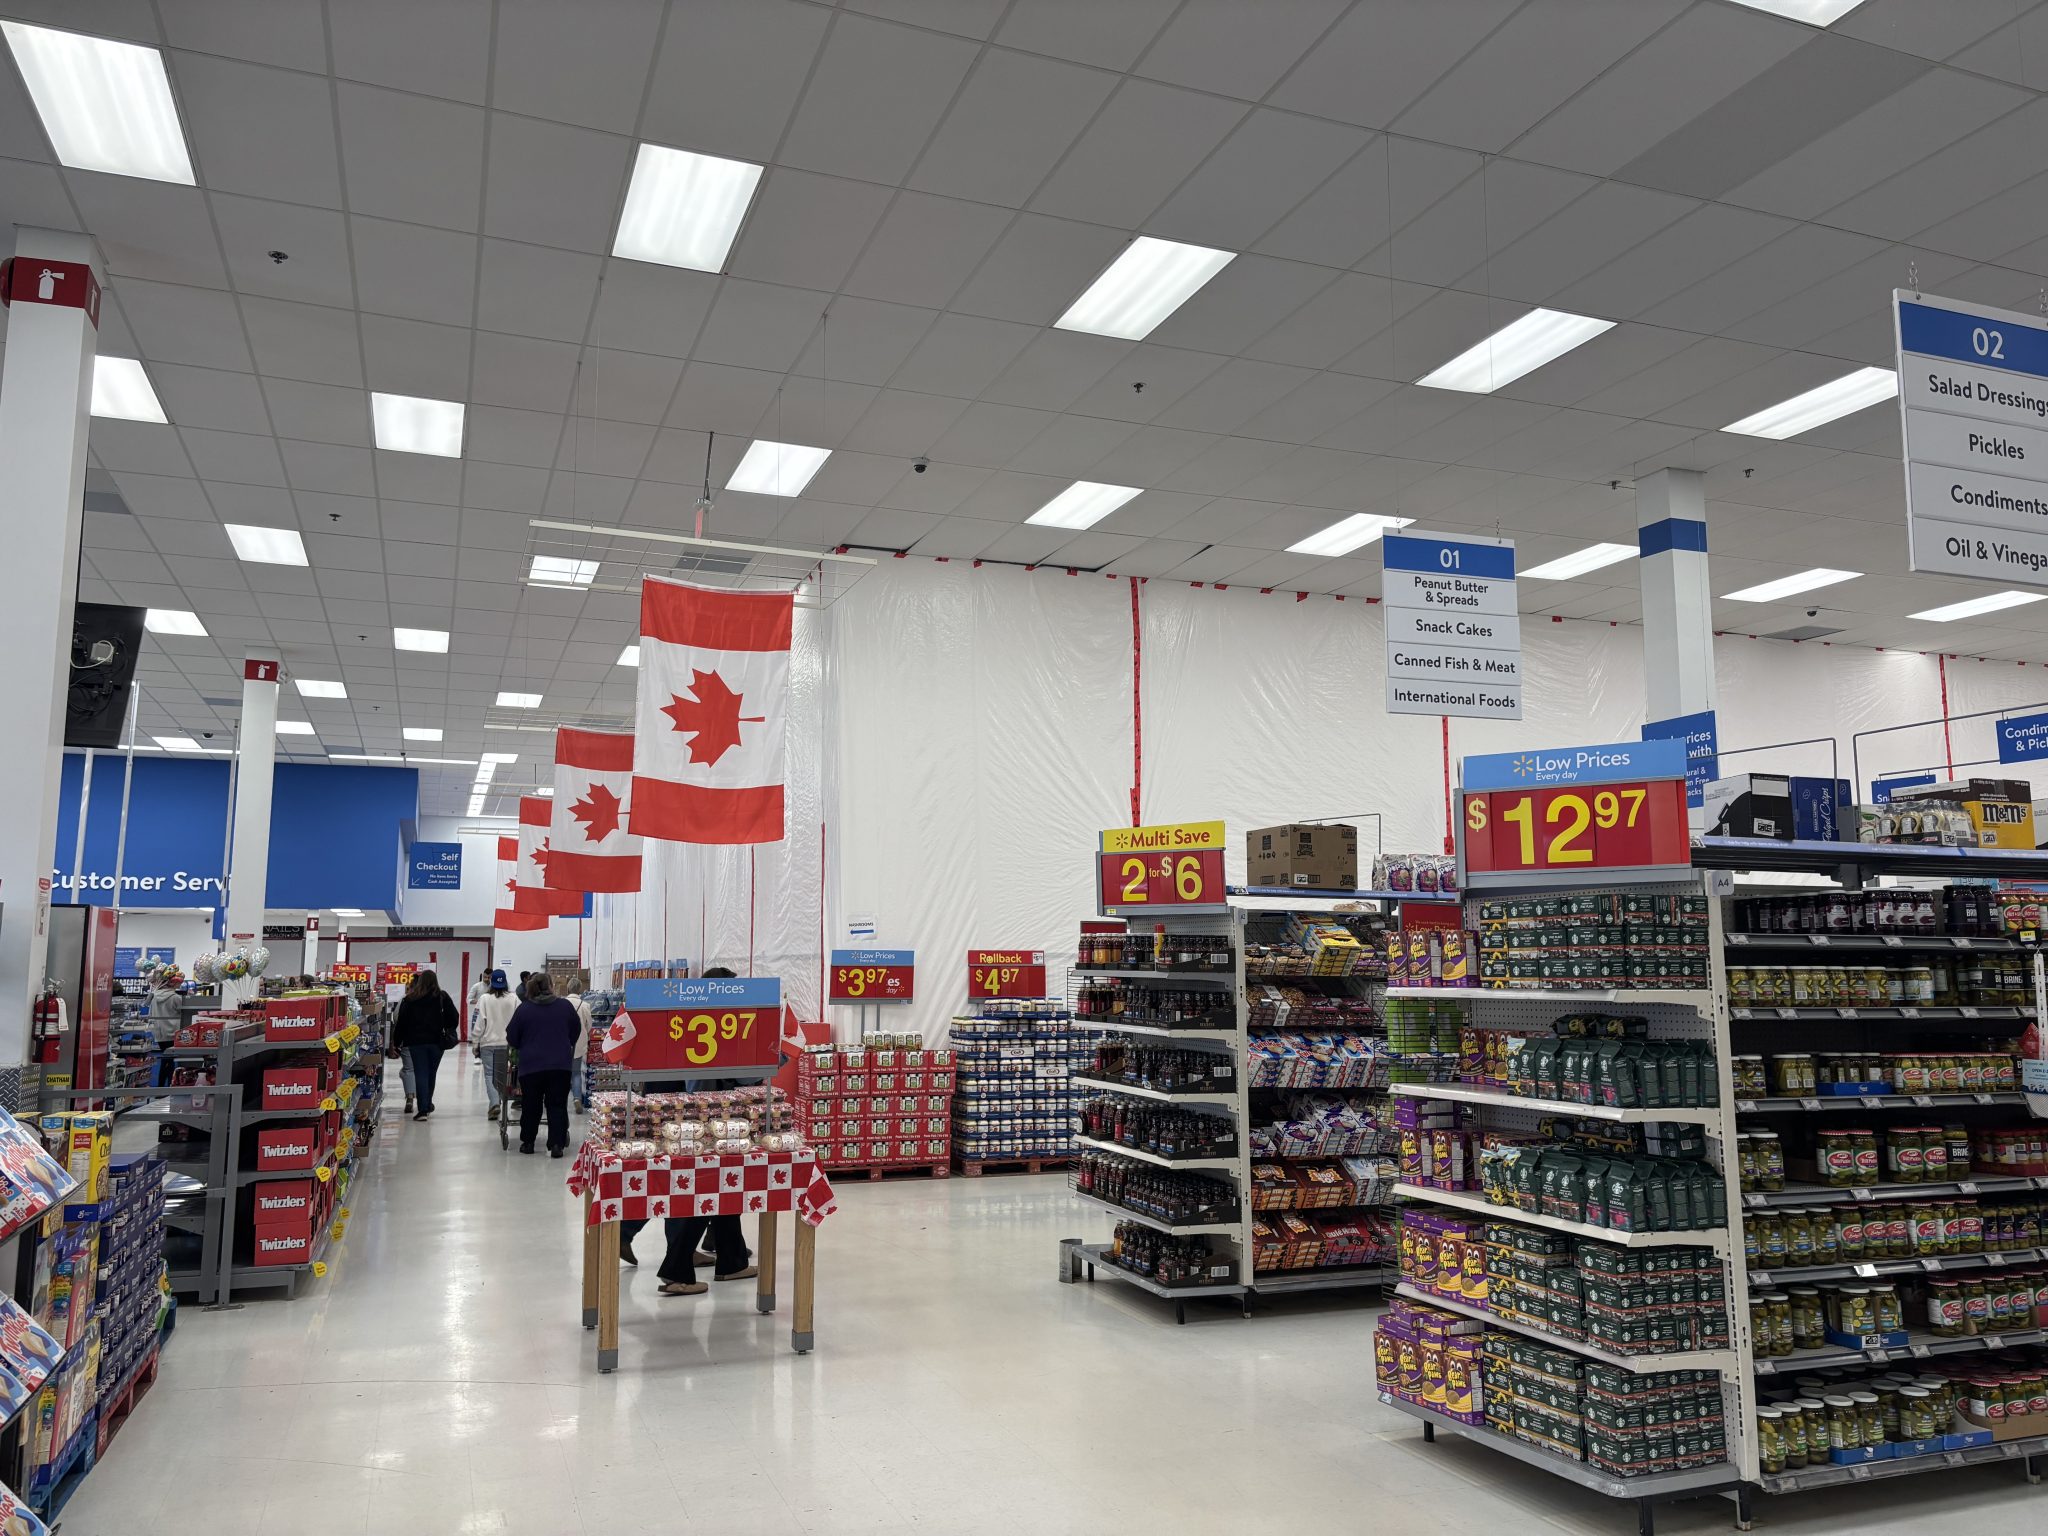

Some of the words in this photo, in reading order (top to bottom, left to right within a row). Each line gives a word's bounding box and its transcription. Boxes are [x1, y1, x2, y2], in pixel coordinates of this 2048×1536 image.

[1972, 327, 2004, 360] 02
[1929, 374, 1972, 399] Salad
[1978, 383, 2048, 417] Dressing
[1968, 433, 2025, 460] Pickles
[1946, 537, 1970, 558] Oil
[1976, 543, 1988, 560] &
[1440, 548, 1460, 568] 01
[1414, 576, 1452, 590] Peanut
[1455, 580, 1488, 594] Butter
[1426, 591, 1434, 602] &
[1436, 592, 1479, 606] Spreads
[1416, 619, 1452, 634] Snack
[1456, 622, 1492, 637] Cakes
[1394, 654, 1441, 668] Canned
[1445, 657, 1469, 670] Fish
[1473, 659, 1482, 672] &
[1485, 660, 1516, 674] Meat
[1394, 688, 1475, 706] International
[1480, 694, 1516, 708] Foods
[1688, 744, 1712, 758] with
[2016, 740, 2026, 752] &
[1536, 756, 1572, 772] Low
[1576, 751, 1631, 768] Prices
[1536, 772, 1560, 782] Every
[1562, 770, 1578, 780] day
[1130, 830, 1170, 848] Multi
[1174, 828, 1210, 845] Save
[416, 862, 458, 871] Checkout
[1122, 858, 1148, 902] 2
[1149, 866, 1160, 878] for
[1718, 879, 1730, 887] A4
[980, 953, 1022, 964] Rollback
[679, 982, 705, 995] Low
[708, 982, 745, 994] Prices
[270, 1016, 316, 1028] Twizzlers
[267, 1084, 312, 1095] Twizzlers
[262, 1145, 308, 1157] Twizzlers
[260, 1197, 306, 1209] Twizzlers
[260, 1238, 306, 1250] Twizzlers
